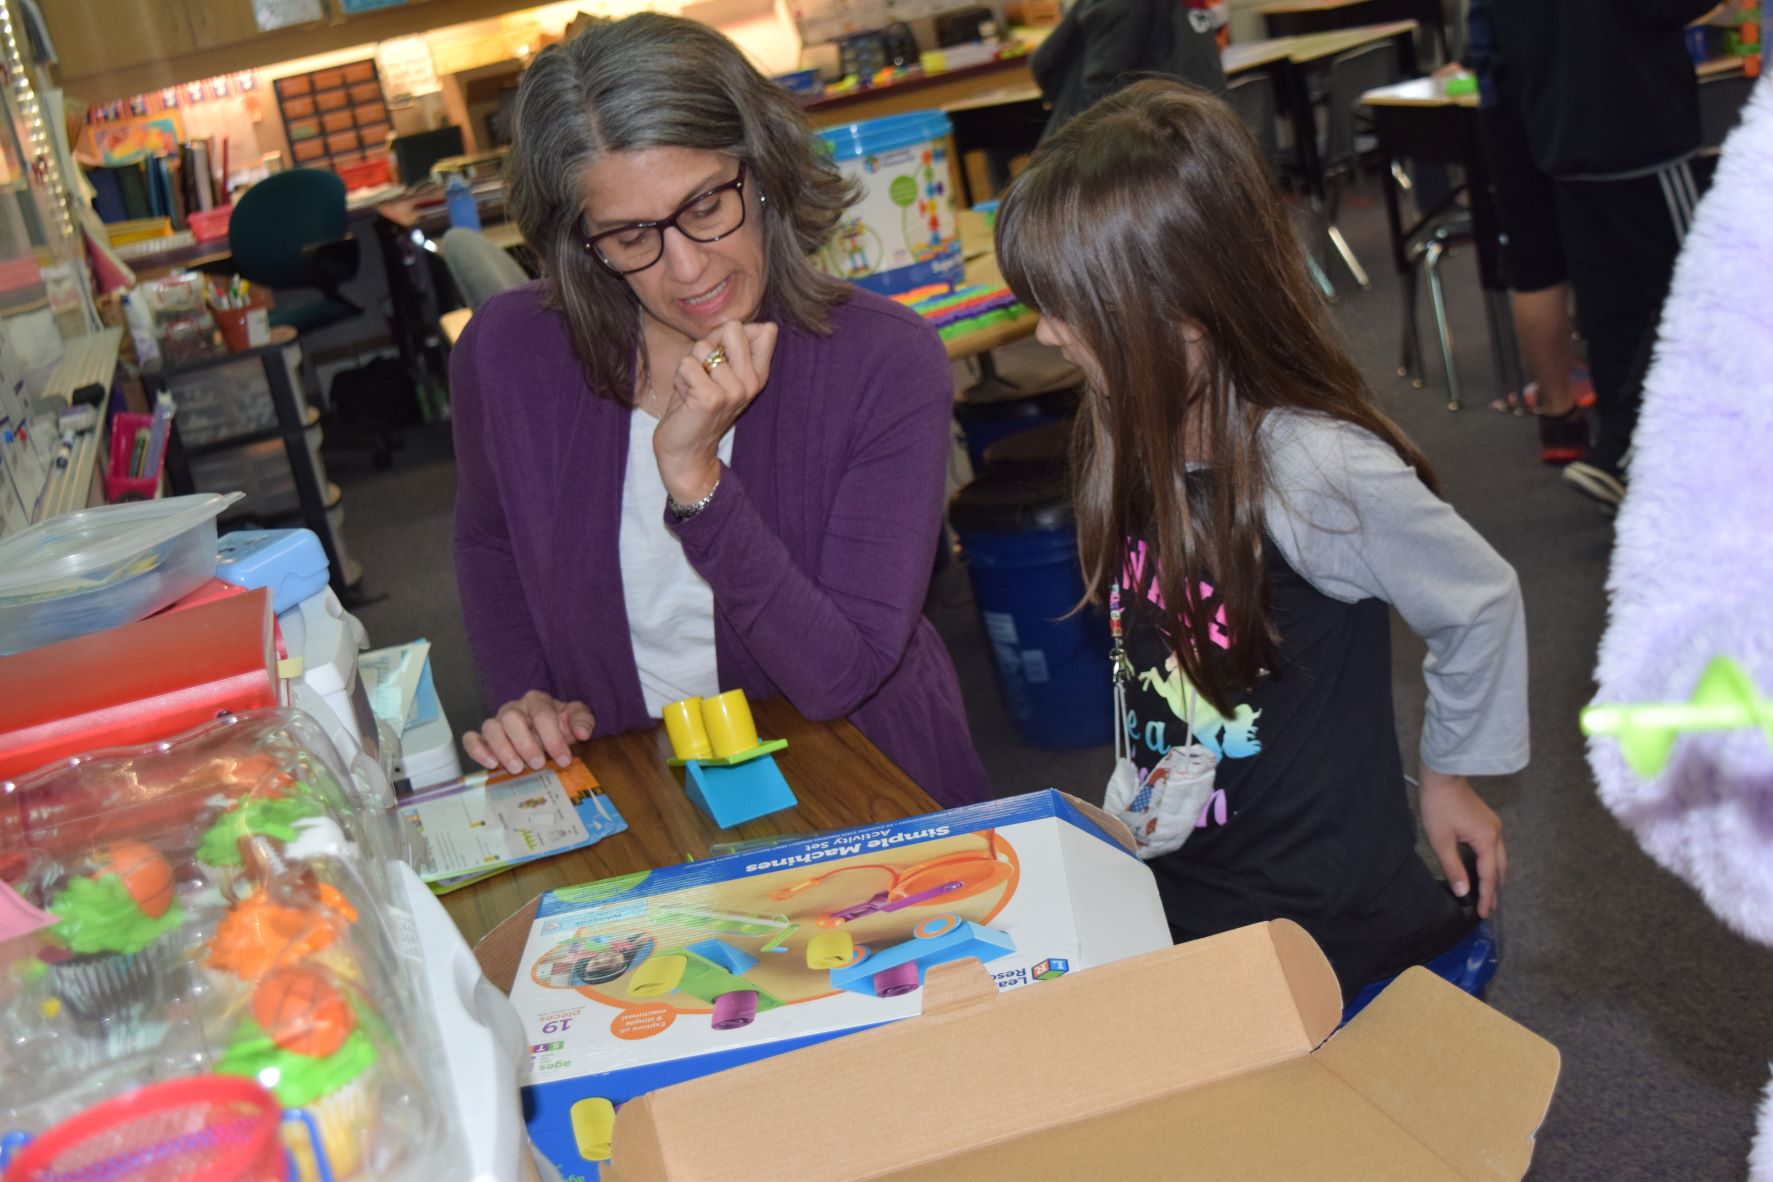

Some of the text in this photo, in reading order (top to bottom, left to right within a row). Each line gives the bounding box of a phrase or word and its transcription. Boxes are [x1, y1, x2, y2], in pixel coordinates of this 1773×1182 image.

[804, 828, 890, 851] Activity Set
[866, 826, 950, 848] Simple
[745, 842, 862, 872] Machines
[995, 976, 1028, 988] Lea
[539, 1008, 582, 1022] pieces
[542, 1018, 573, 1034] 19
[632, 1021, 666, 1032] Explore
[539, 1060, 572, 1071] ages
